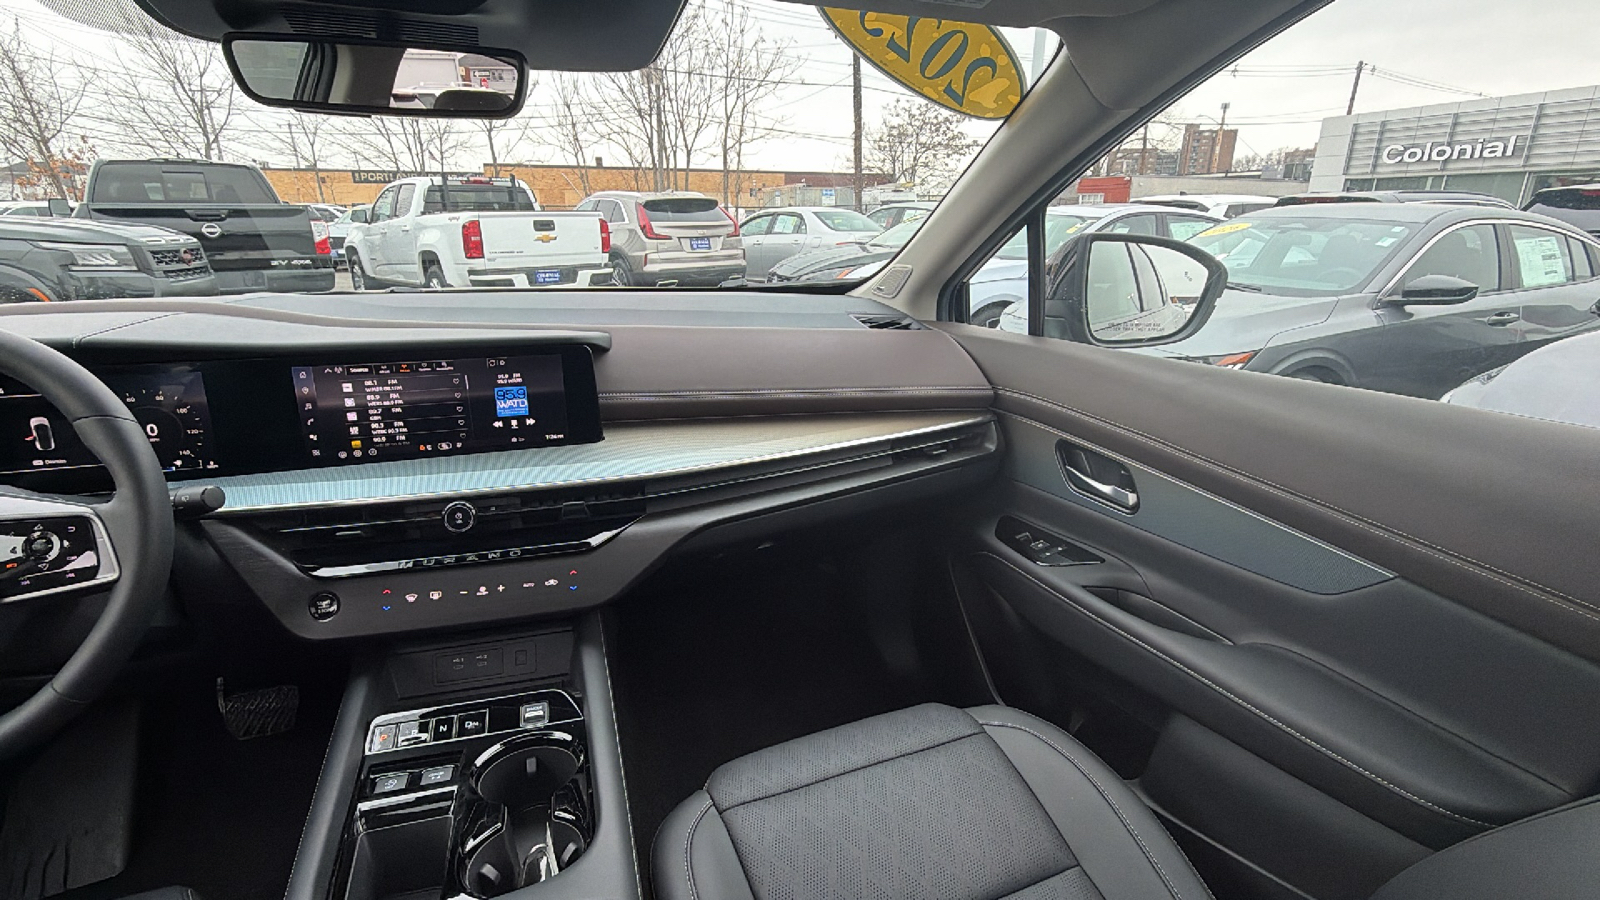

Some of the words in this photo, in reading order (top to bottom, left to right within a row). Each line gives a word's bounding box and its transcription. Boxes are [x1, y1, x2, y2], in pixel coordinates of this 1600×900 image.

[1382, 135, 1518, 164] Colonial
[496, 388, 526, 401] 95.9
[497, 400, 527, 409] WATD
[146, 423, 159, 437] 0
[400, 550, 521, 569] MURANO
[380, 734, 387, 742] P
